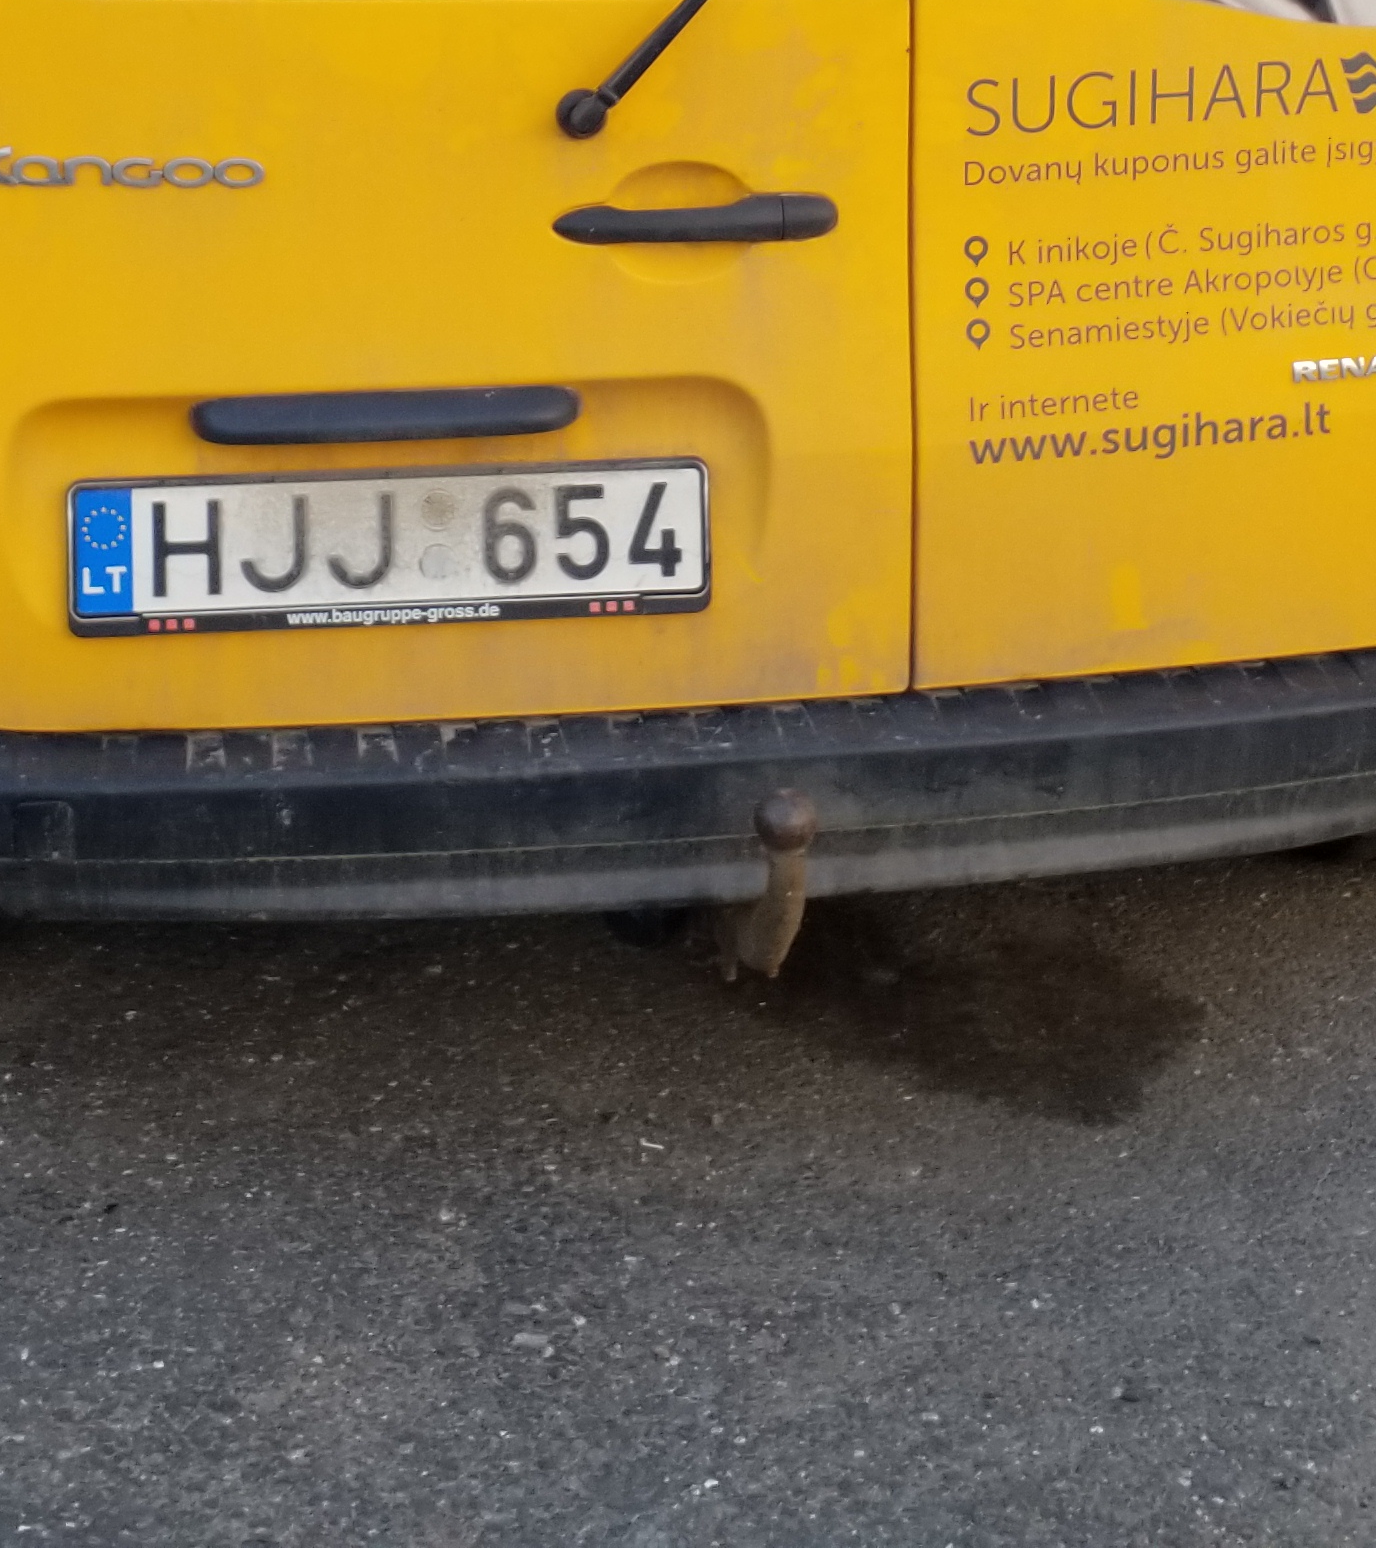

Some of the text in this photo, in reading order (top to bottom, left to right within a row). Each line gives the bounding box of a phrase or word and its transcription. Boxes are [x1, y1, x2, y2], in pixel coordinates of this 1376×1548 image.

[966, 57, 1339, 136] SUGIHARA
[963, 158, 1083, 187] Dovanų
[1093, 150, 1226, 180] kuponus
[1235, 140, 1318, 174] galite
[1199, 222, 1346, 256] Sugiharos
[1008, 279, 1067, 309] SPA
[1075, 275, 1174, 304] centre
[1184, 265, 1343, 296] Akropolyje
[1009, 311, 1210, 351] Senamiestyje
[968, 387, 1139, 424] Ir internete
[970, 402, 1332, 466] www.sugihara.lt
[150, 481, 683, 598] HJJ 654
[82, 566, 128, 598] LT
[286, 603, 500, 626] www.baugruppe-gross.de
